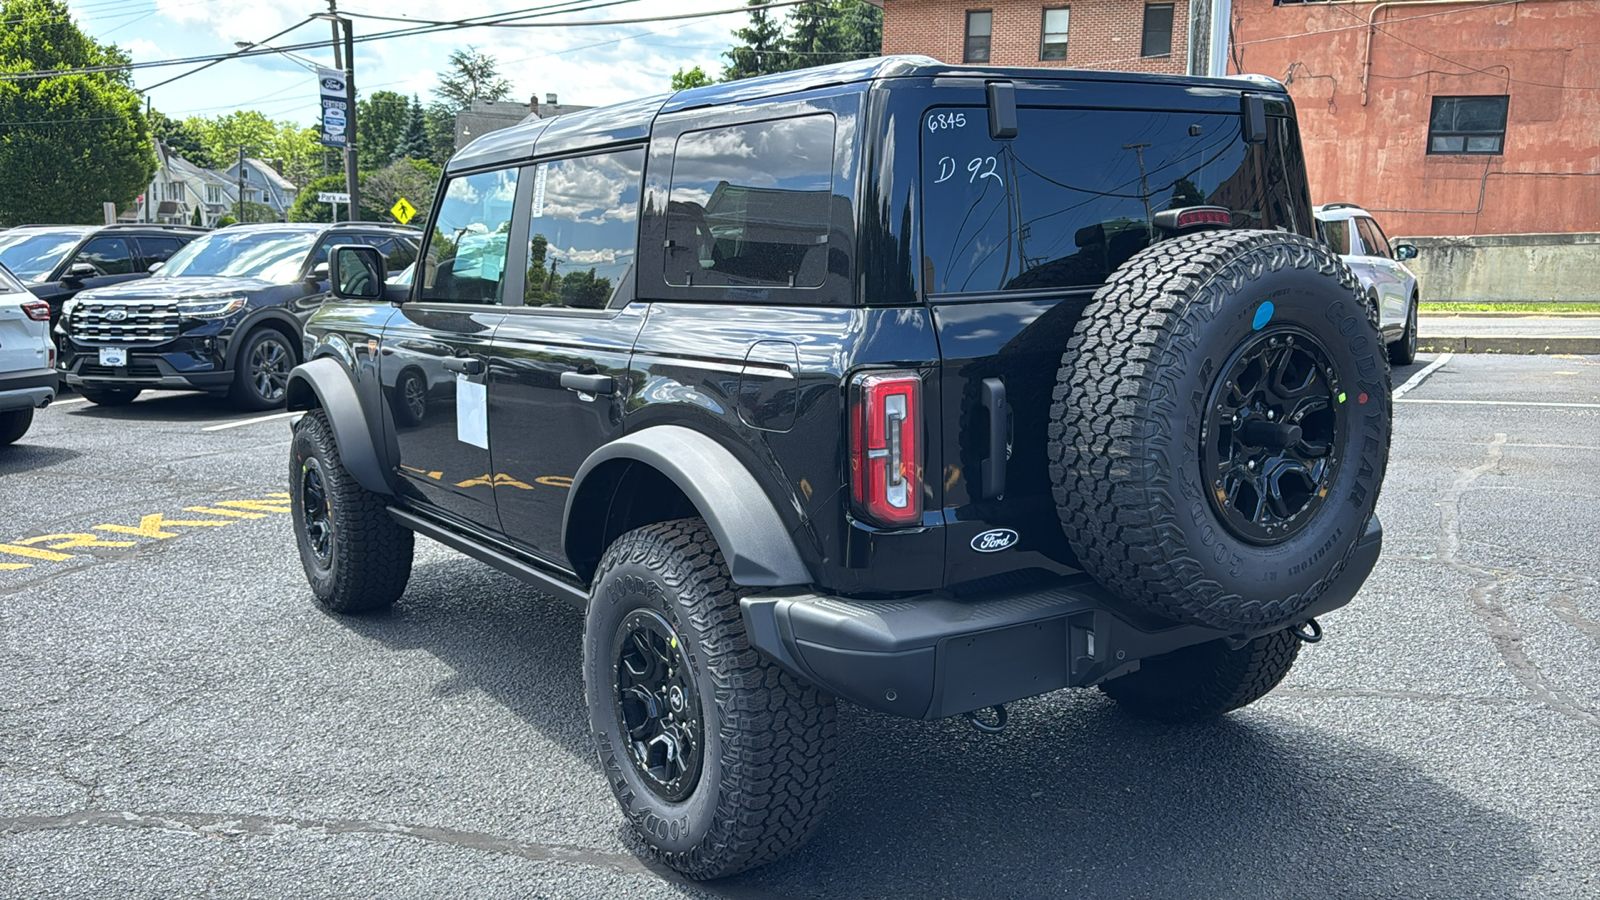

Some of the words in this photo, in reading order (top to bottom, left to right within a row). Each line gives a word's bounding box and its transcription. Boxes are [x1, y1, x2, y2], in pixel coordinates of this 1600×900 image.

[323, 99, 347, 111] CERTIFIED
[928, 112, 967, 133] 6845
[322, 133, 346, 143] PRE-OWNED
[934, 156, 956, 184] D
[967, 156, 1003, 187] 92
[321, 193, 336, 201] Park
[980, 532, 1011, 549] Ford
[1288, 527, 1343, 577] TERRITORY
